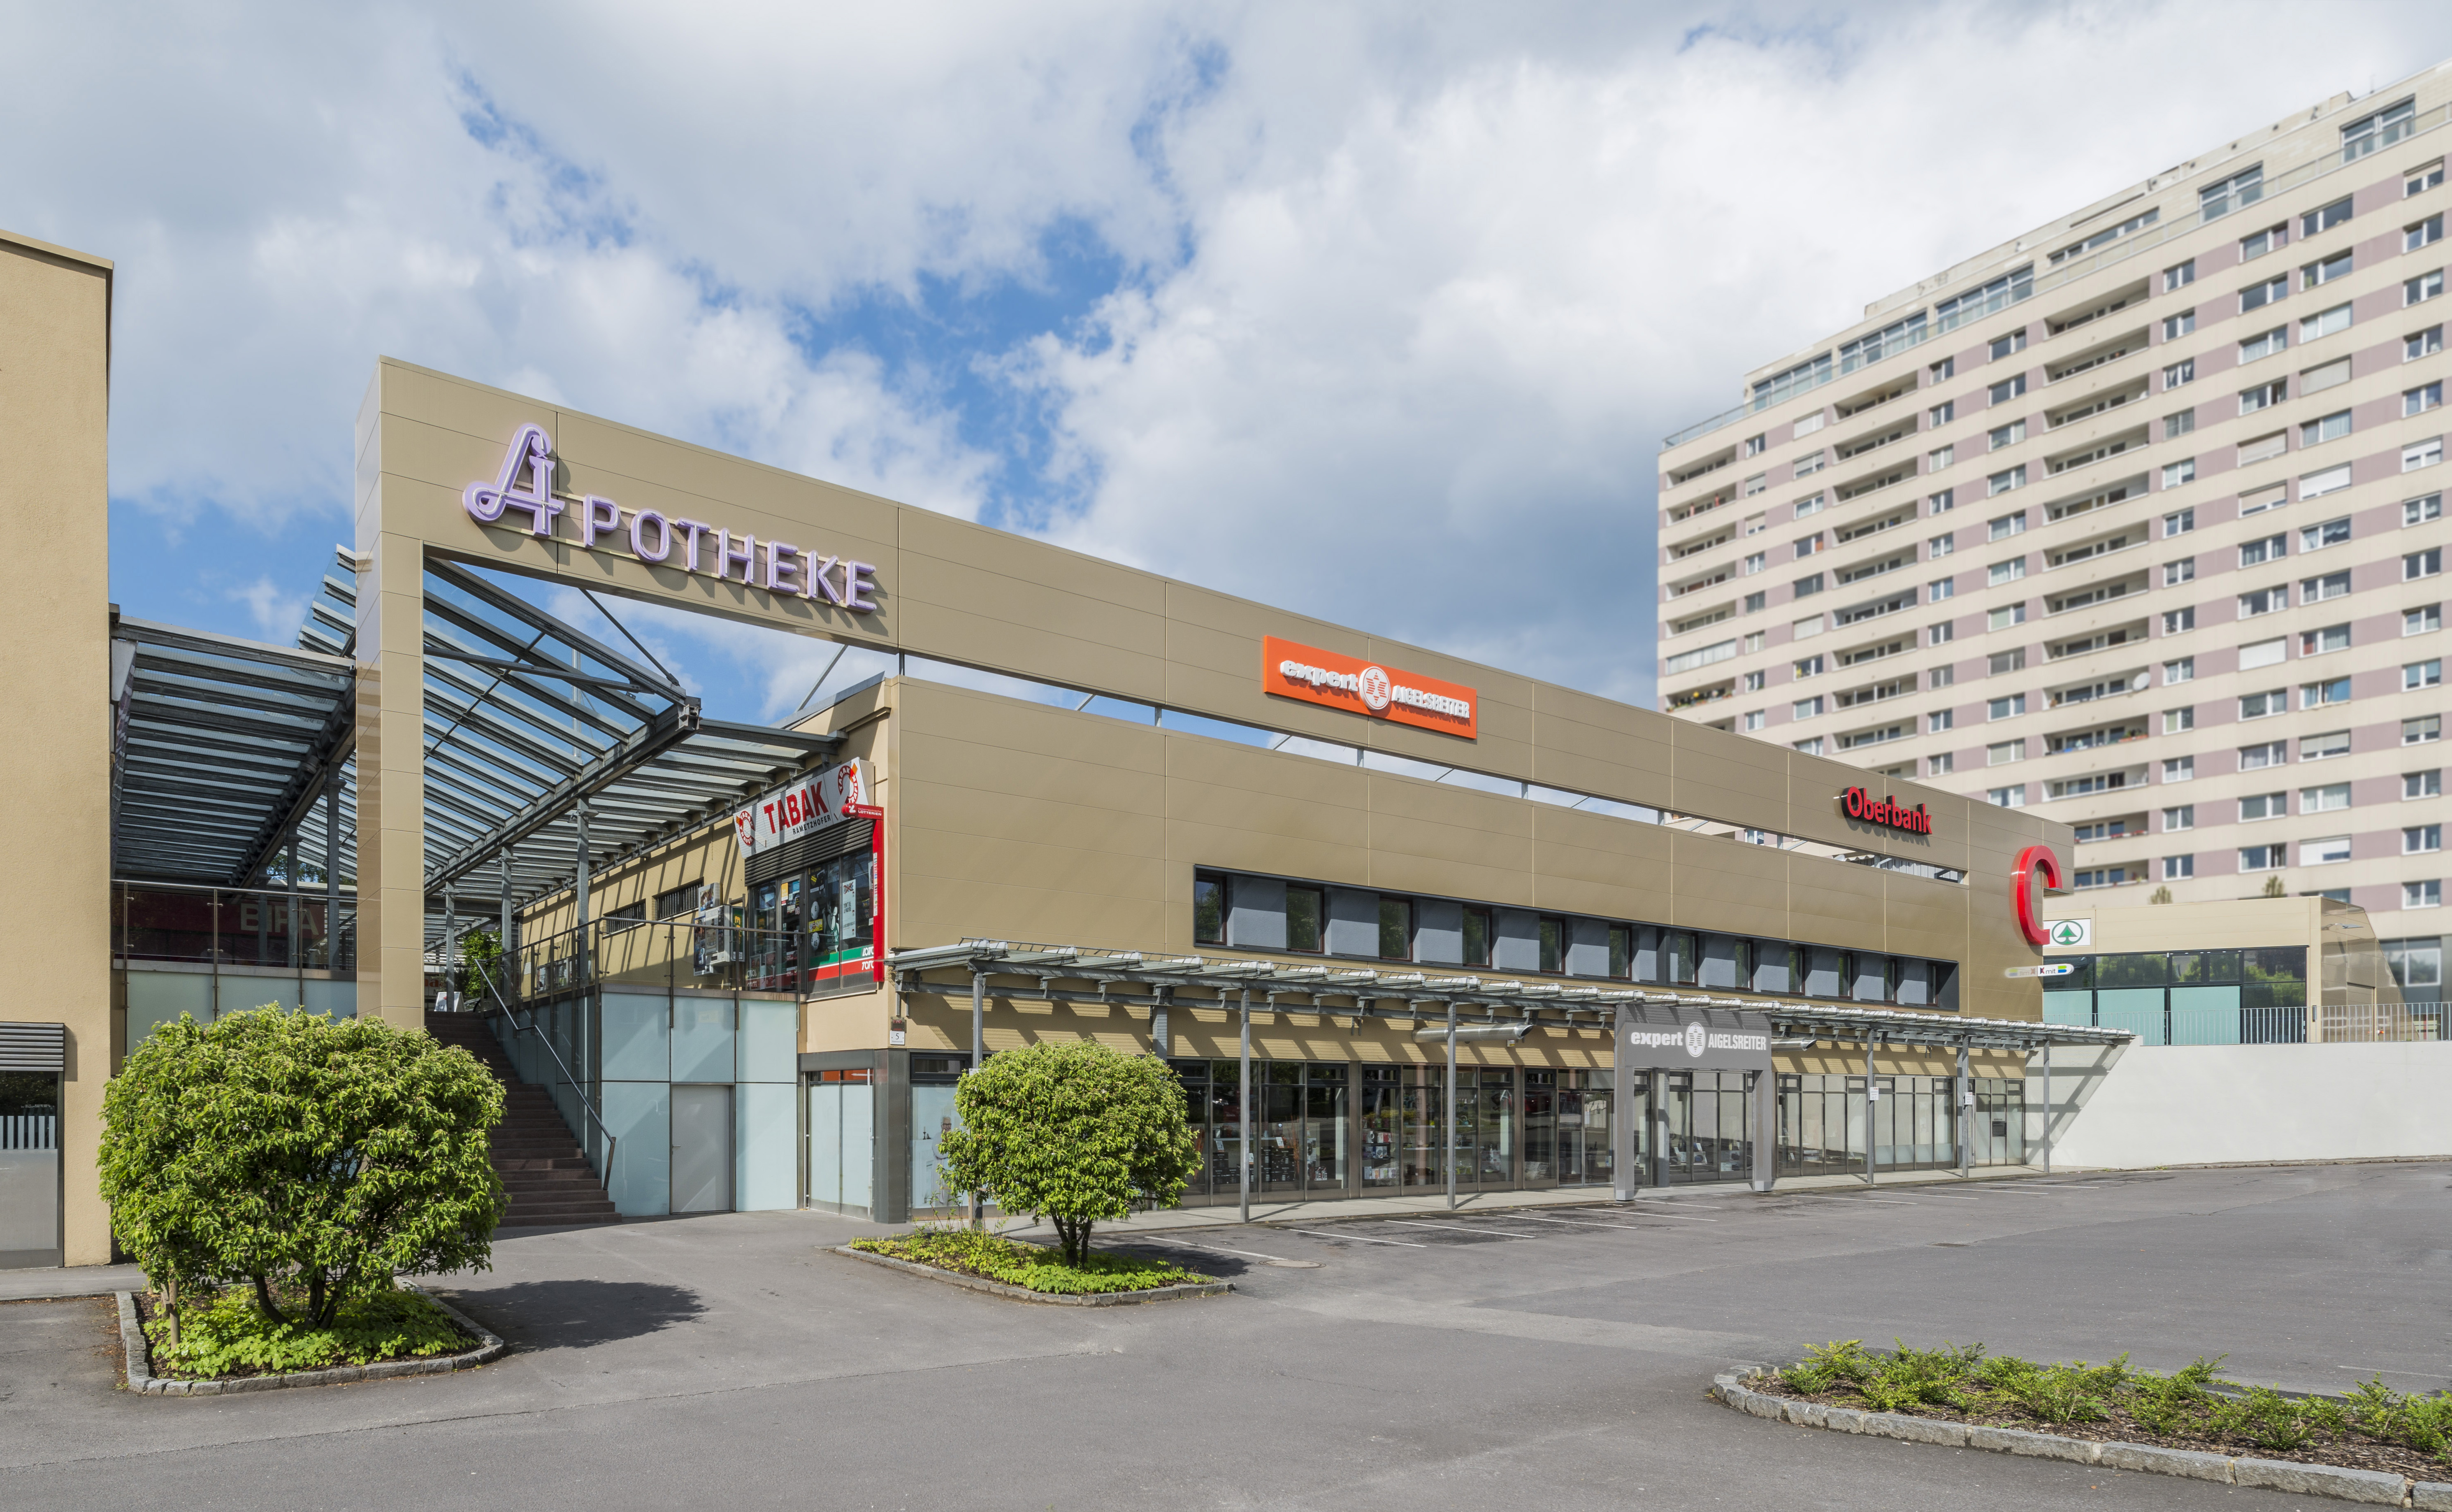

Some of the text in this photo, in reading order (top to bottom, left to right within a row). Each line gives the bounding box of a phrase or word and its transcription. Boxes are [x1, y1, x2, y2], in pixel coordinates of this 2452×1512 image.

[462, 422, 877, 613] APOTHEKE
[1280, 660, 1470, 719] expert AIGELSREITER
[838, 767, 850, 792] TABAK
[848, 774, 858, 804] TRAFIK
[763, 780, 829, 834] TABAK
[1842, 786, 1932, 835] Oberbank
[792, 814, 831, 835] RAMETZHOFER
[241, 903, 319, 935] BIPA
[1631, 1031, 1766, 1050] expert AIGELSREITER
